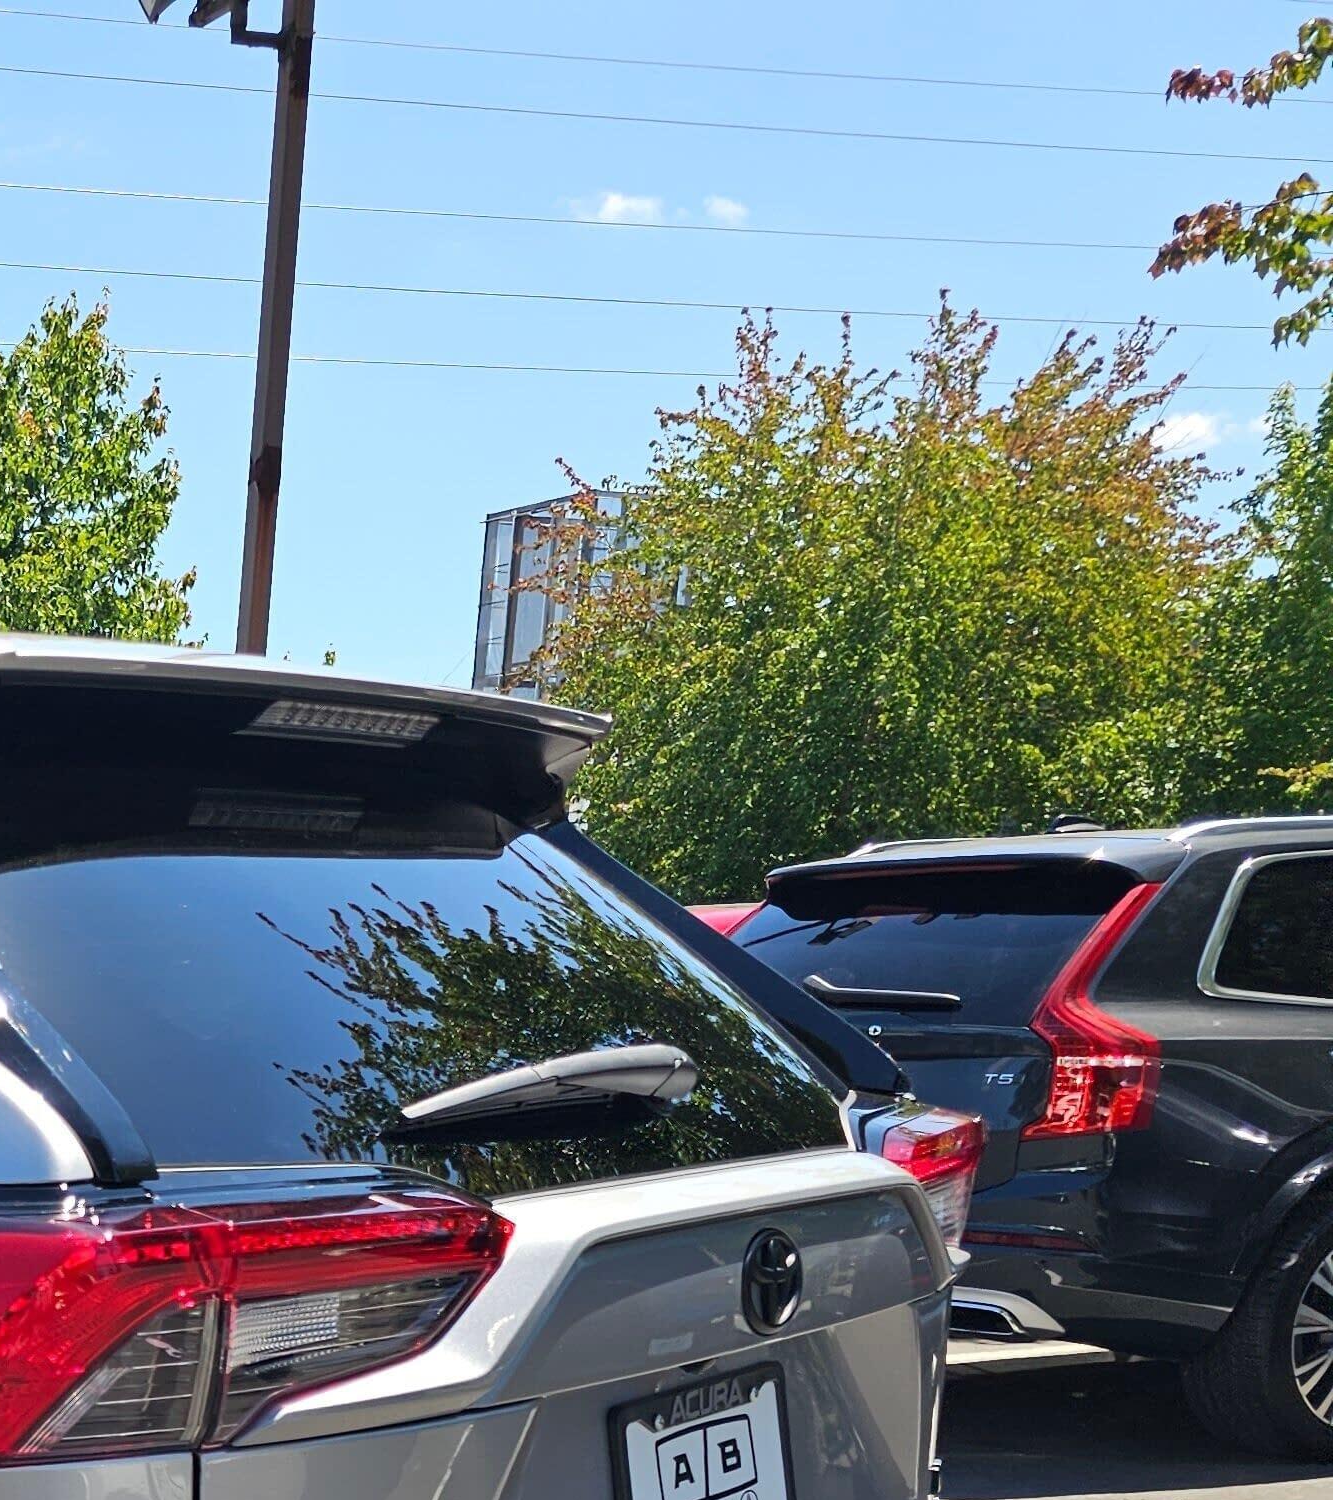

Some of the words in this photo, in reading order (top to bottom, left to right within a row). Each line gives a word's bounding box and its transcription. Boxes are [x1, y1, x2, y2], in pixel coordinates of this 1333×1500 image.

[983, 1072, 1015, 1085] T5
[670, 1380, 745, 1425] ACURA
[672, 1452, 696, 1490] A
[717, 1437, 742, 1474] B
